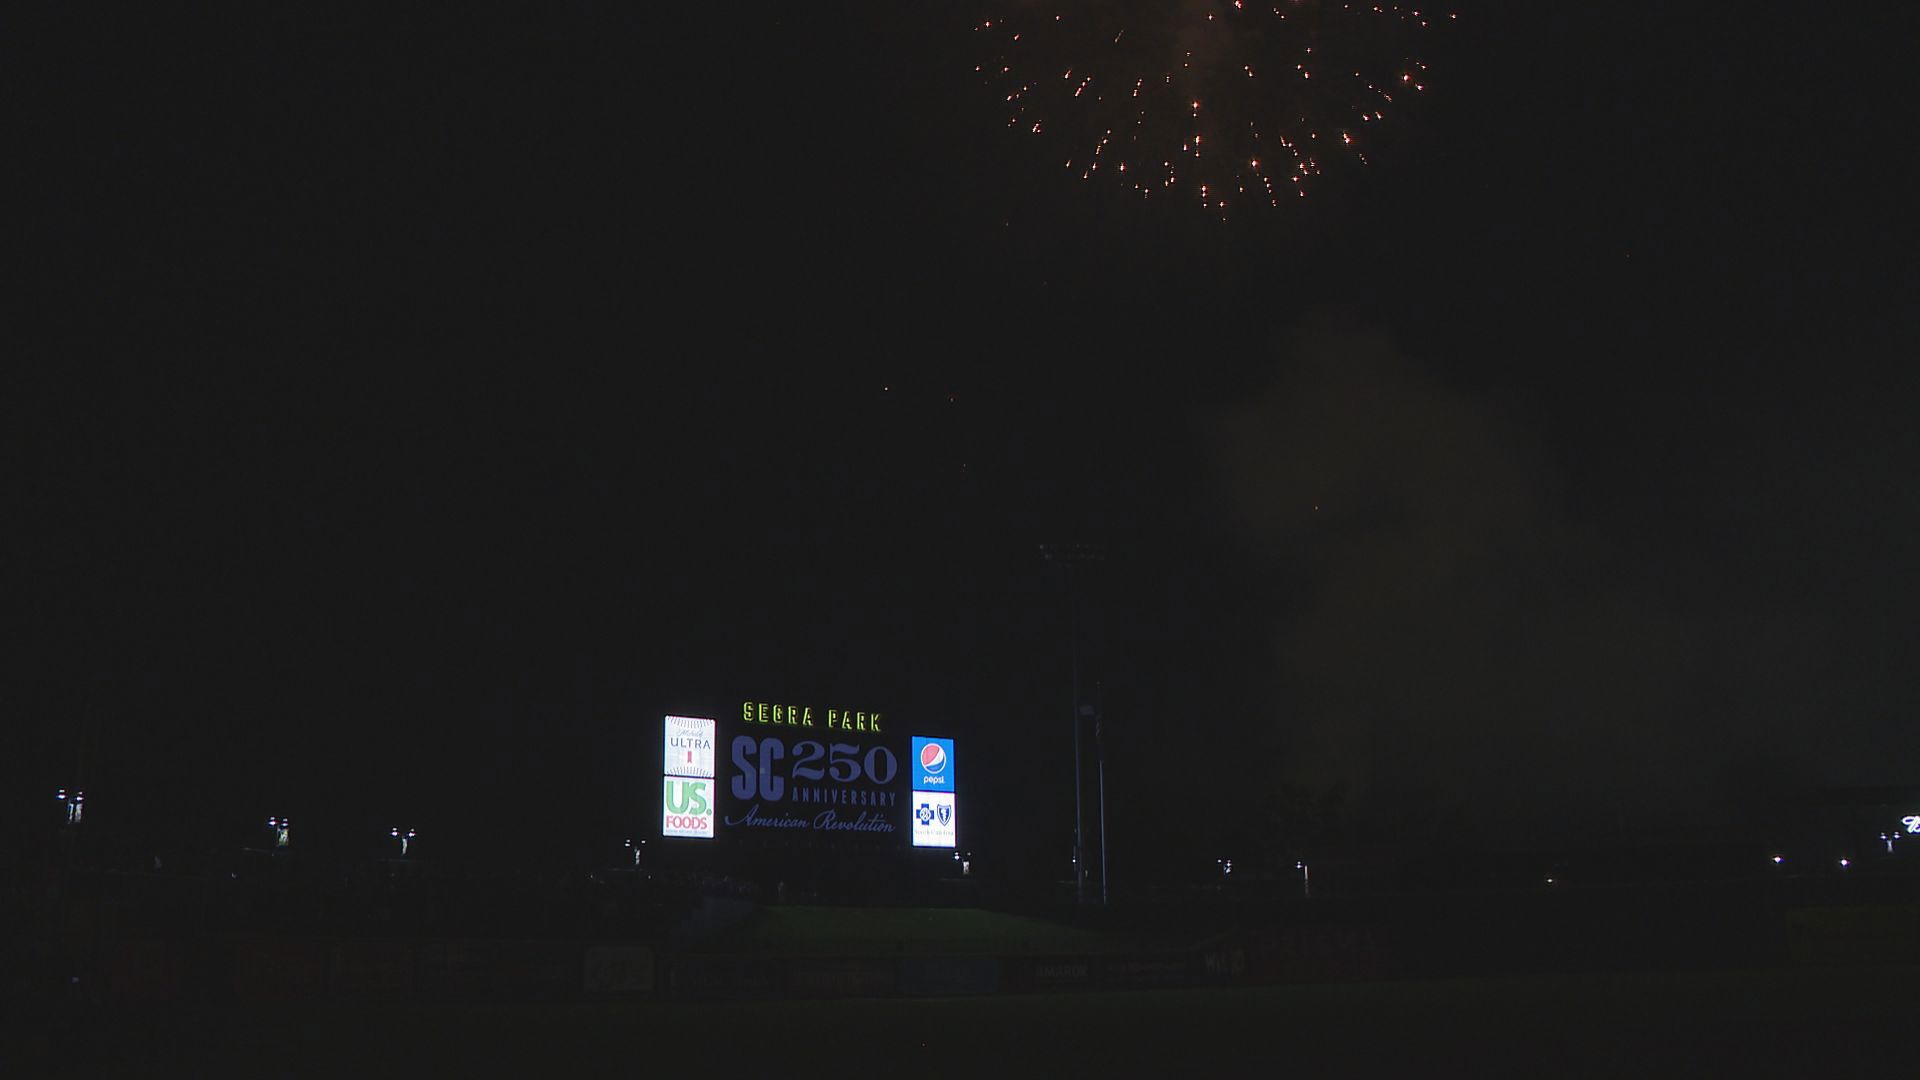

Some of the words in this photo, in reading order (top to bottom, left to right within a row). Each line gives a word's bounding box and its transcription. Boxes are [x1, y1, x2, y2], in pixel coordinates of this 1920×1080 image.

[742, 701, 814, 728] SEGRA
[828, 708, 882, 733] PARK
[670, 737, 712, 750] ULTRA
[731, 735, 784, 802] SC
[791, 740, 898, 785] 250
[923, 775, 946, 786] pepsi
[791, 786, 896, 809] ANNIVERSARY
[665, 815, 708, 830] FOODS
[724, 804, 811, 829] American
[812, 809, 897, 833] Revolution
